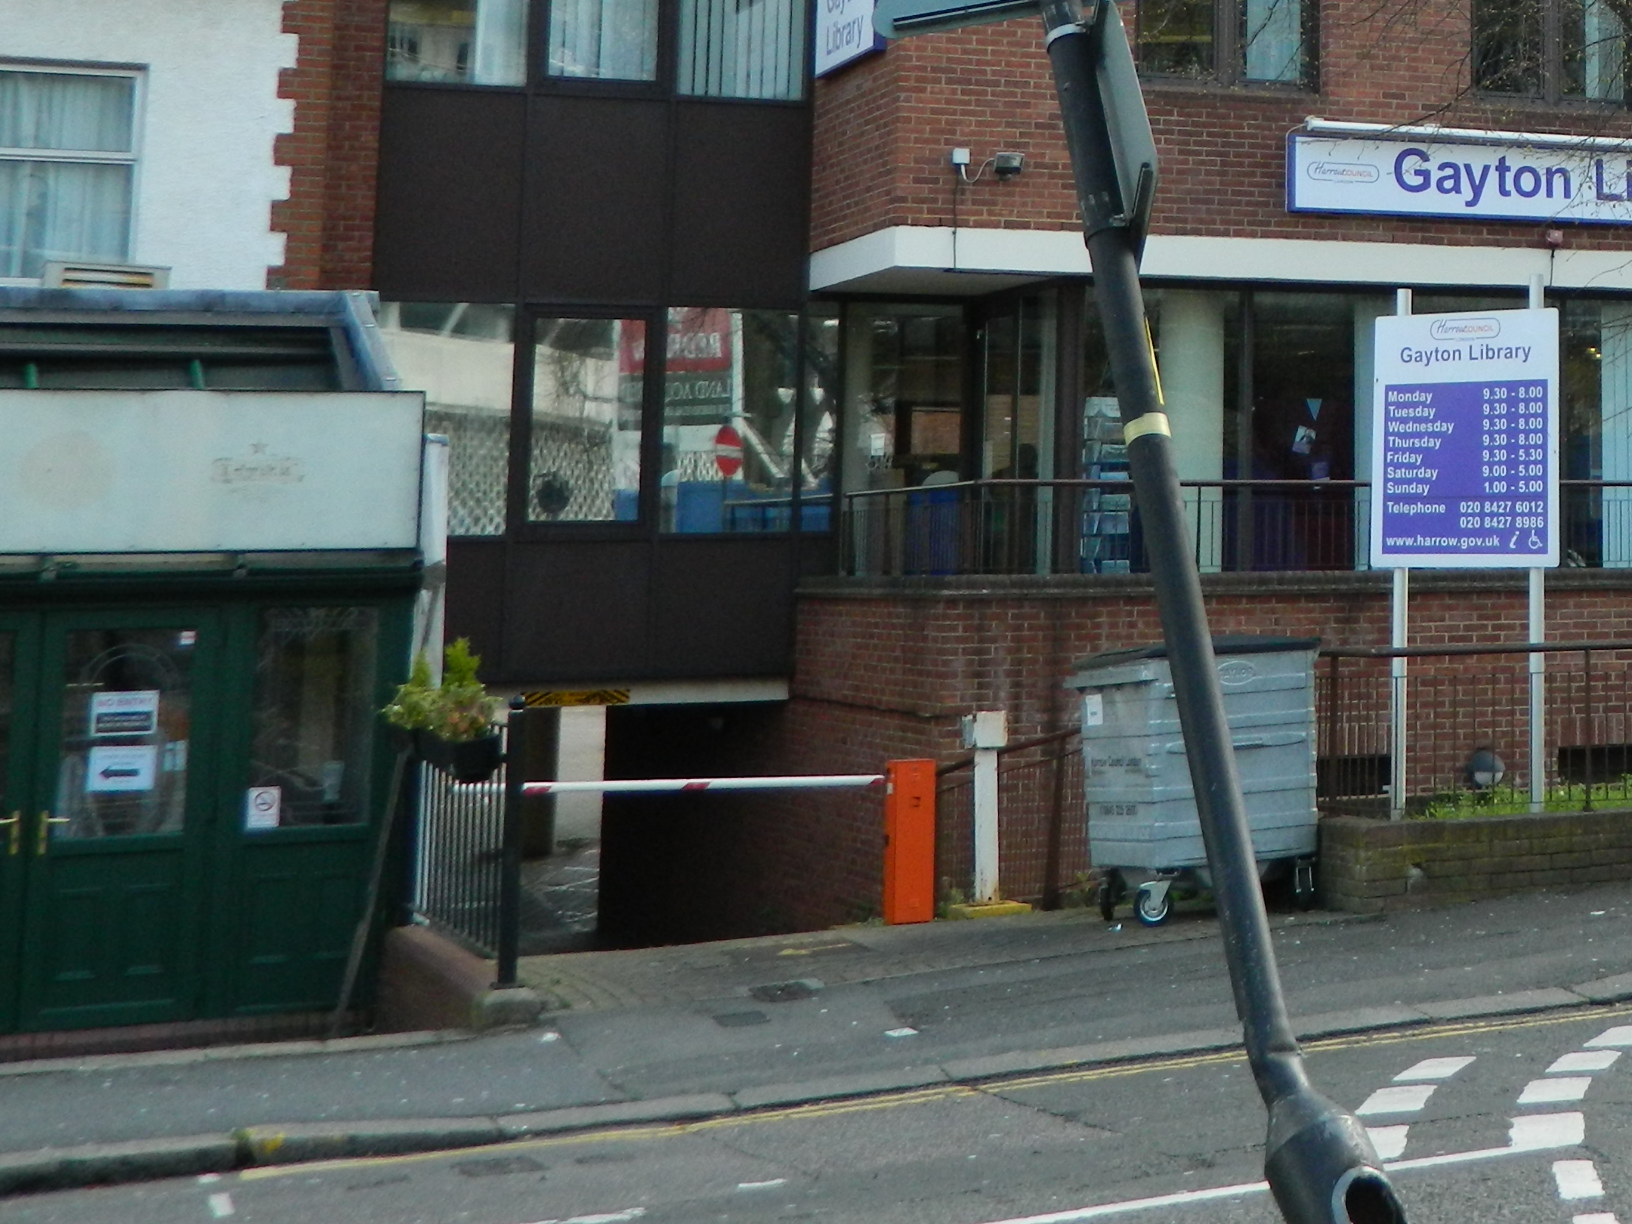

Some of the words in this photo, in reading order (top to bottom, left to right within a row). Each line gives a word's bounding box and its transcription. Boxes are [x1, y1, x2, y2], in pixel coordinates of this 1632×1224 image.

[826, 15, 864, 55] Library
[1394, 147, 1572, 207] Gayton
[1400, 347, 1462, 366] Gayton
[1469, 344, 1532, 363] Library
[1388, 391, 1432, 404] Monday
[1483, 388, 1507, 399] 9.30
[1519, 387, 1542, 398] 8.00
[1389, 406, 1435, 419] Tuesday
[1483, 403, 1507, 415] 9.30
[1519, 402, 1542, 413] 8.00
[1388, 421, 1454, 434] Wednesday
[1483, 419, 1507, 430] 9.30
[1519, 418, 1542, 429] 8.00
[1388, 436, 1441, 449] Thursday
[1483, 434, 1507, 445] 9.30
[1519, 433, 1542, 445] 8.00
[1387, 451, 1422, 465] Friday
[1483, 450, 1507, 461] 9.30
[1519, 449, 1542, 460] 5.30
[1387, 467, 1438, 480] Saturday
[1483, 466, 1507, 477] 9.00
[1519, 465, 1542, 476] 5.00
[1387, 482, 1429, 496] Sunday
[1485, 481, 1507, 493] 1.00
[1519, 481, 1543, 492] 5.00
[1387, 502, 1445, 516] Telephone
[1460, 502, 1480, 513] 020
[1484, 502, 1511, 513] 8427
[1516, 502, 1544, 513] 6012
[1460, 517, 1480, 528] 020
[1484, 517, 1511, 528] 8427
[1516, 517, 1544, 528] 8986
[1386, 535, 1500, 549] www.harrow.gov.uk
